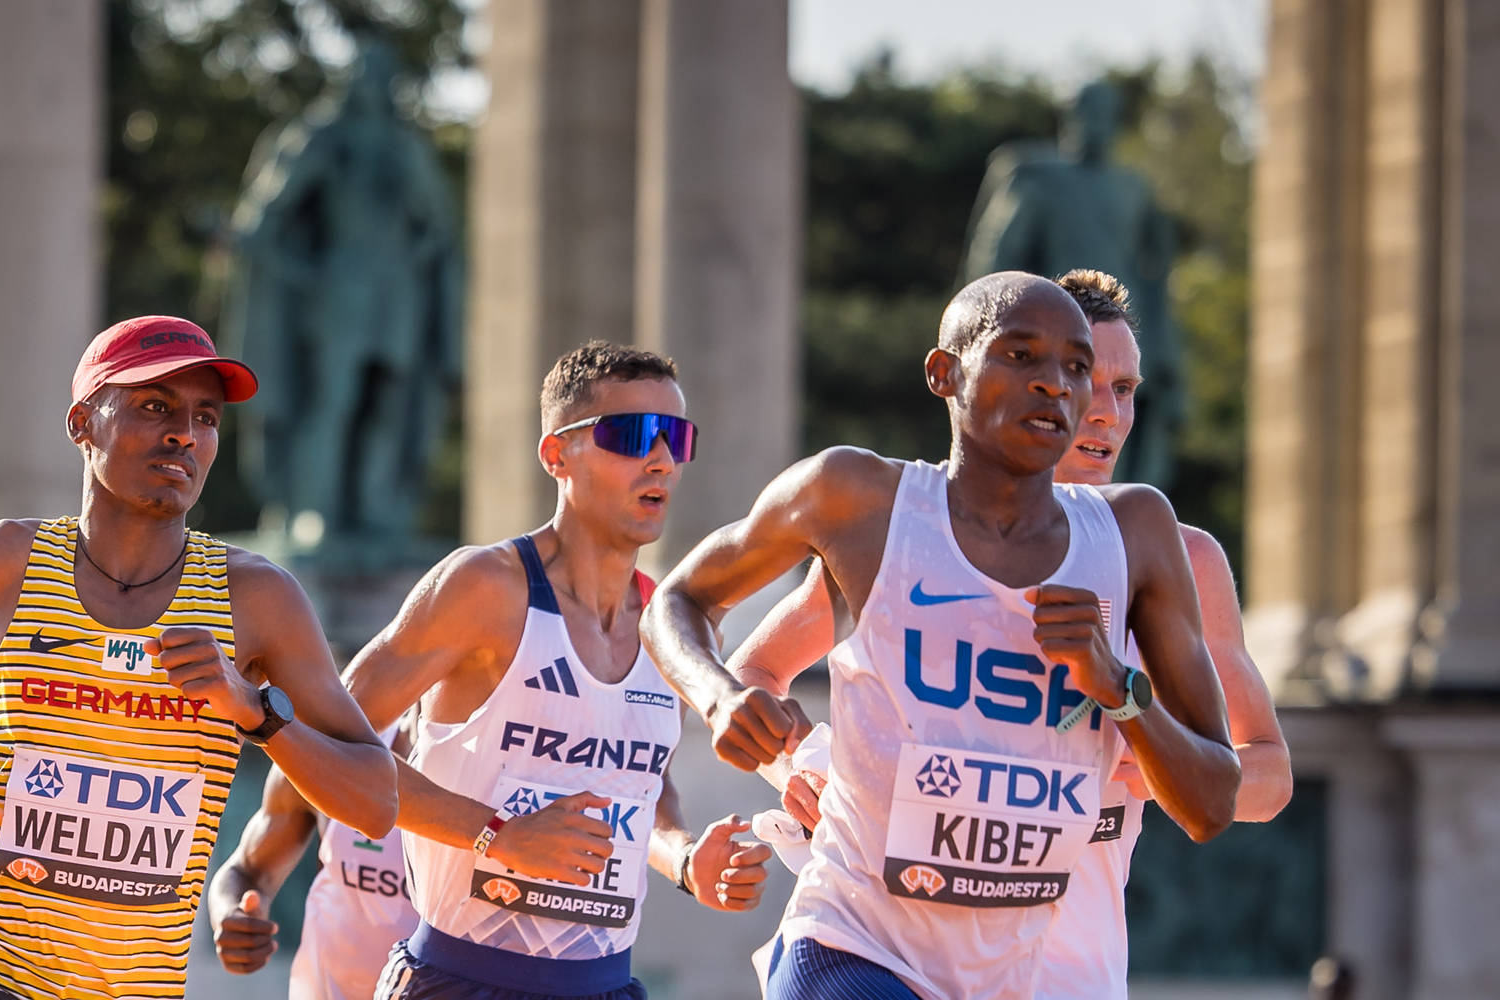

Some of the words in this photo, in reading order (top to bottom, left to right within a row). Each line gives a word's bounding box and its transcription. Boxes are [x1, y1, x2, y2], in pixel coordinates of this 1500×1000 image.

[21, 677, 209, 724] GERMANY
[905, 628, 1101, 731] USA
[500, 721, 670, 776] FRANCE
[66, 763, 192, 817] TDK
[964, 758, 1088, 815] TDK
[15, 805, 185, 869] WELDAY
[931, 812, 1063, 867] KIBET
